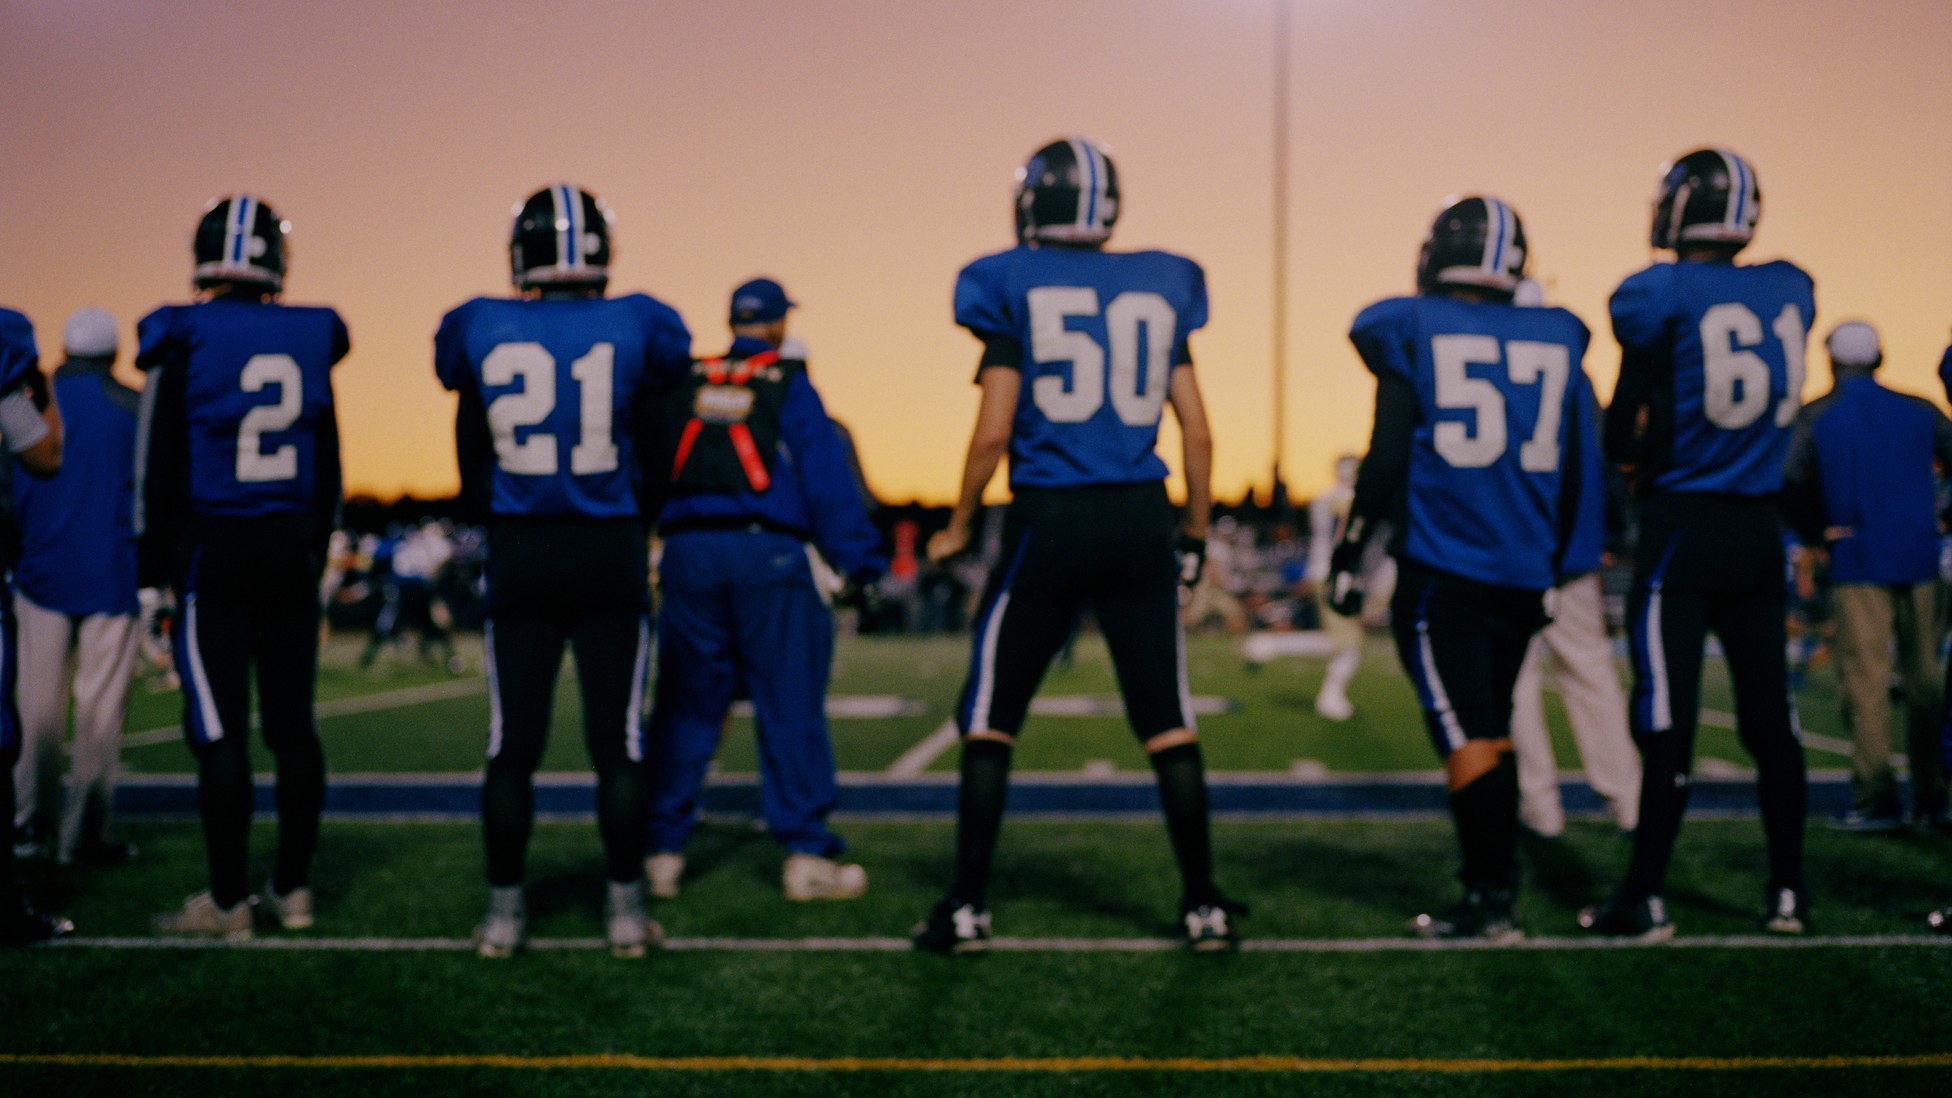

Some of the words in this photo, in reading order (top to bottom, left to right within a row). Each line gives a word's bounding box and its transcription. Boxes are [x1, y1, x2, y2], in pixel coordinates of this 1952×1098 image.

[236, 353, 303, 481] 2
[482, 341, 619, 476] 21
[1027, 286, 1176, 426] 50
[1431, 333, 1570, 473] 57
[1699, 302, 1805, 428] 61
